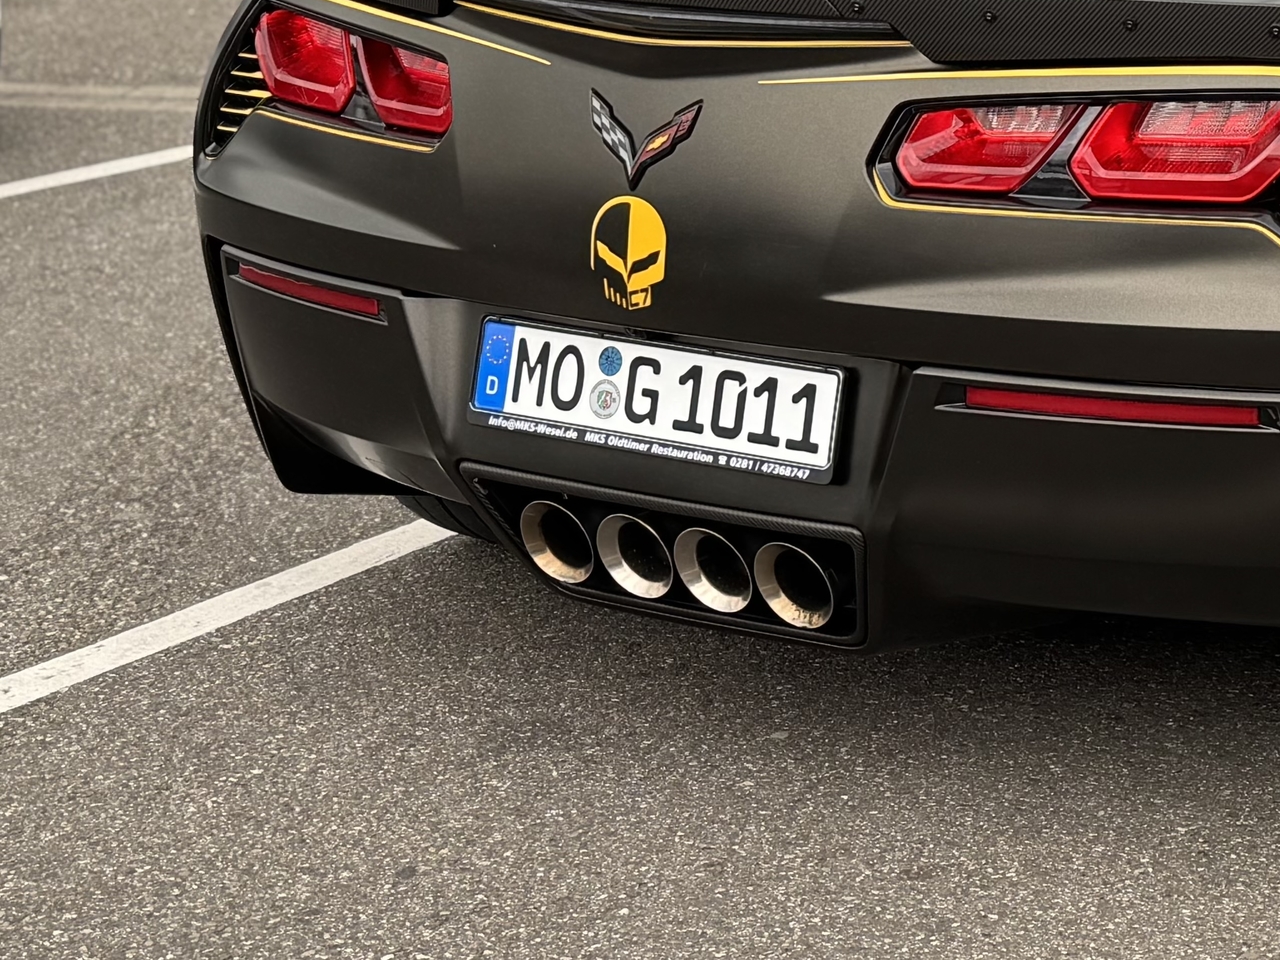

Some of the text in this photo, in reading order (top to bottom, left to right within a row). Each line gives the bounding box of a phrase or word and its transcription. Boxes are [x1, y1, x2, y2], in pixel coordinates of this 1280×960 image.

[629, 286, 650, 308] C7
[485, 375, 499, 395] D
[511, 337, 585, 411] MO
[584, 430, 606, 445] MKS
[607, 433, 650, 453] Oldtimer
[650, 442, 714, 464] Restauration
[729, 456, 754, 471] 0281
